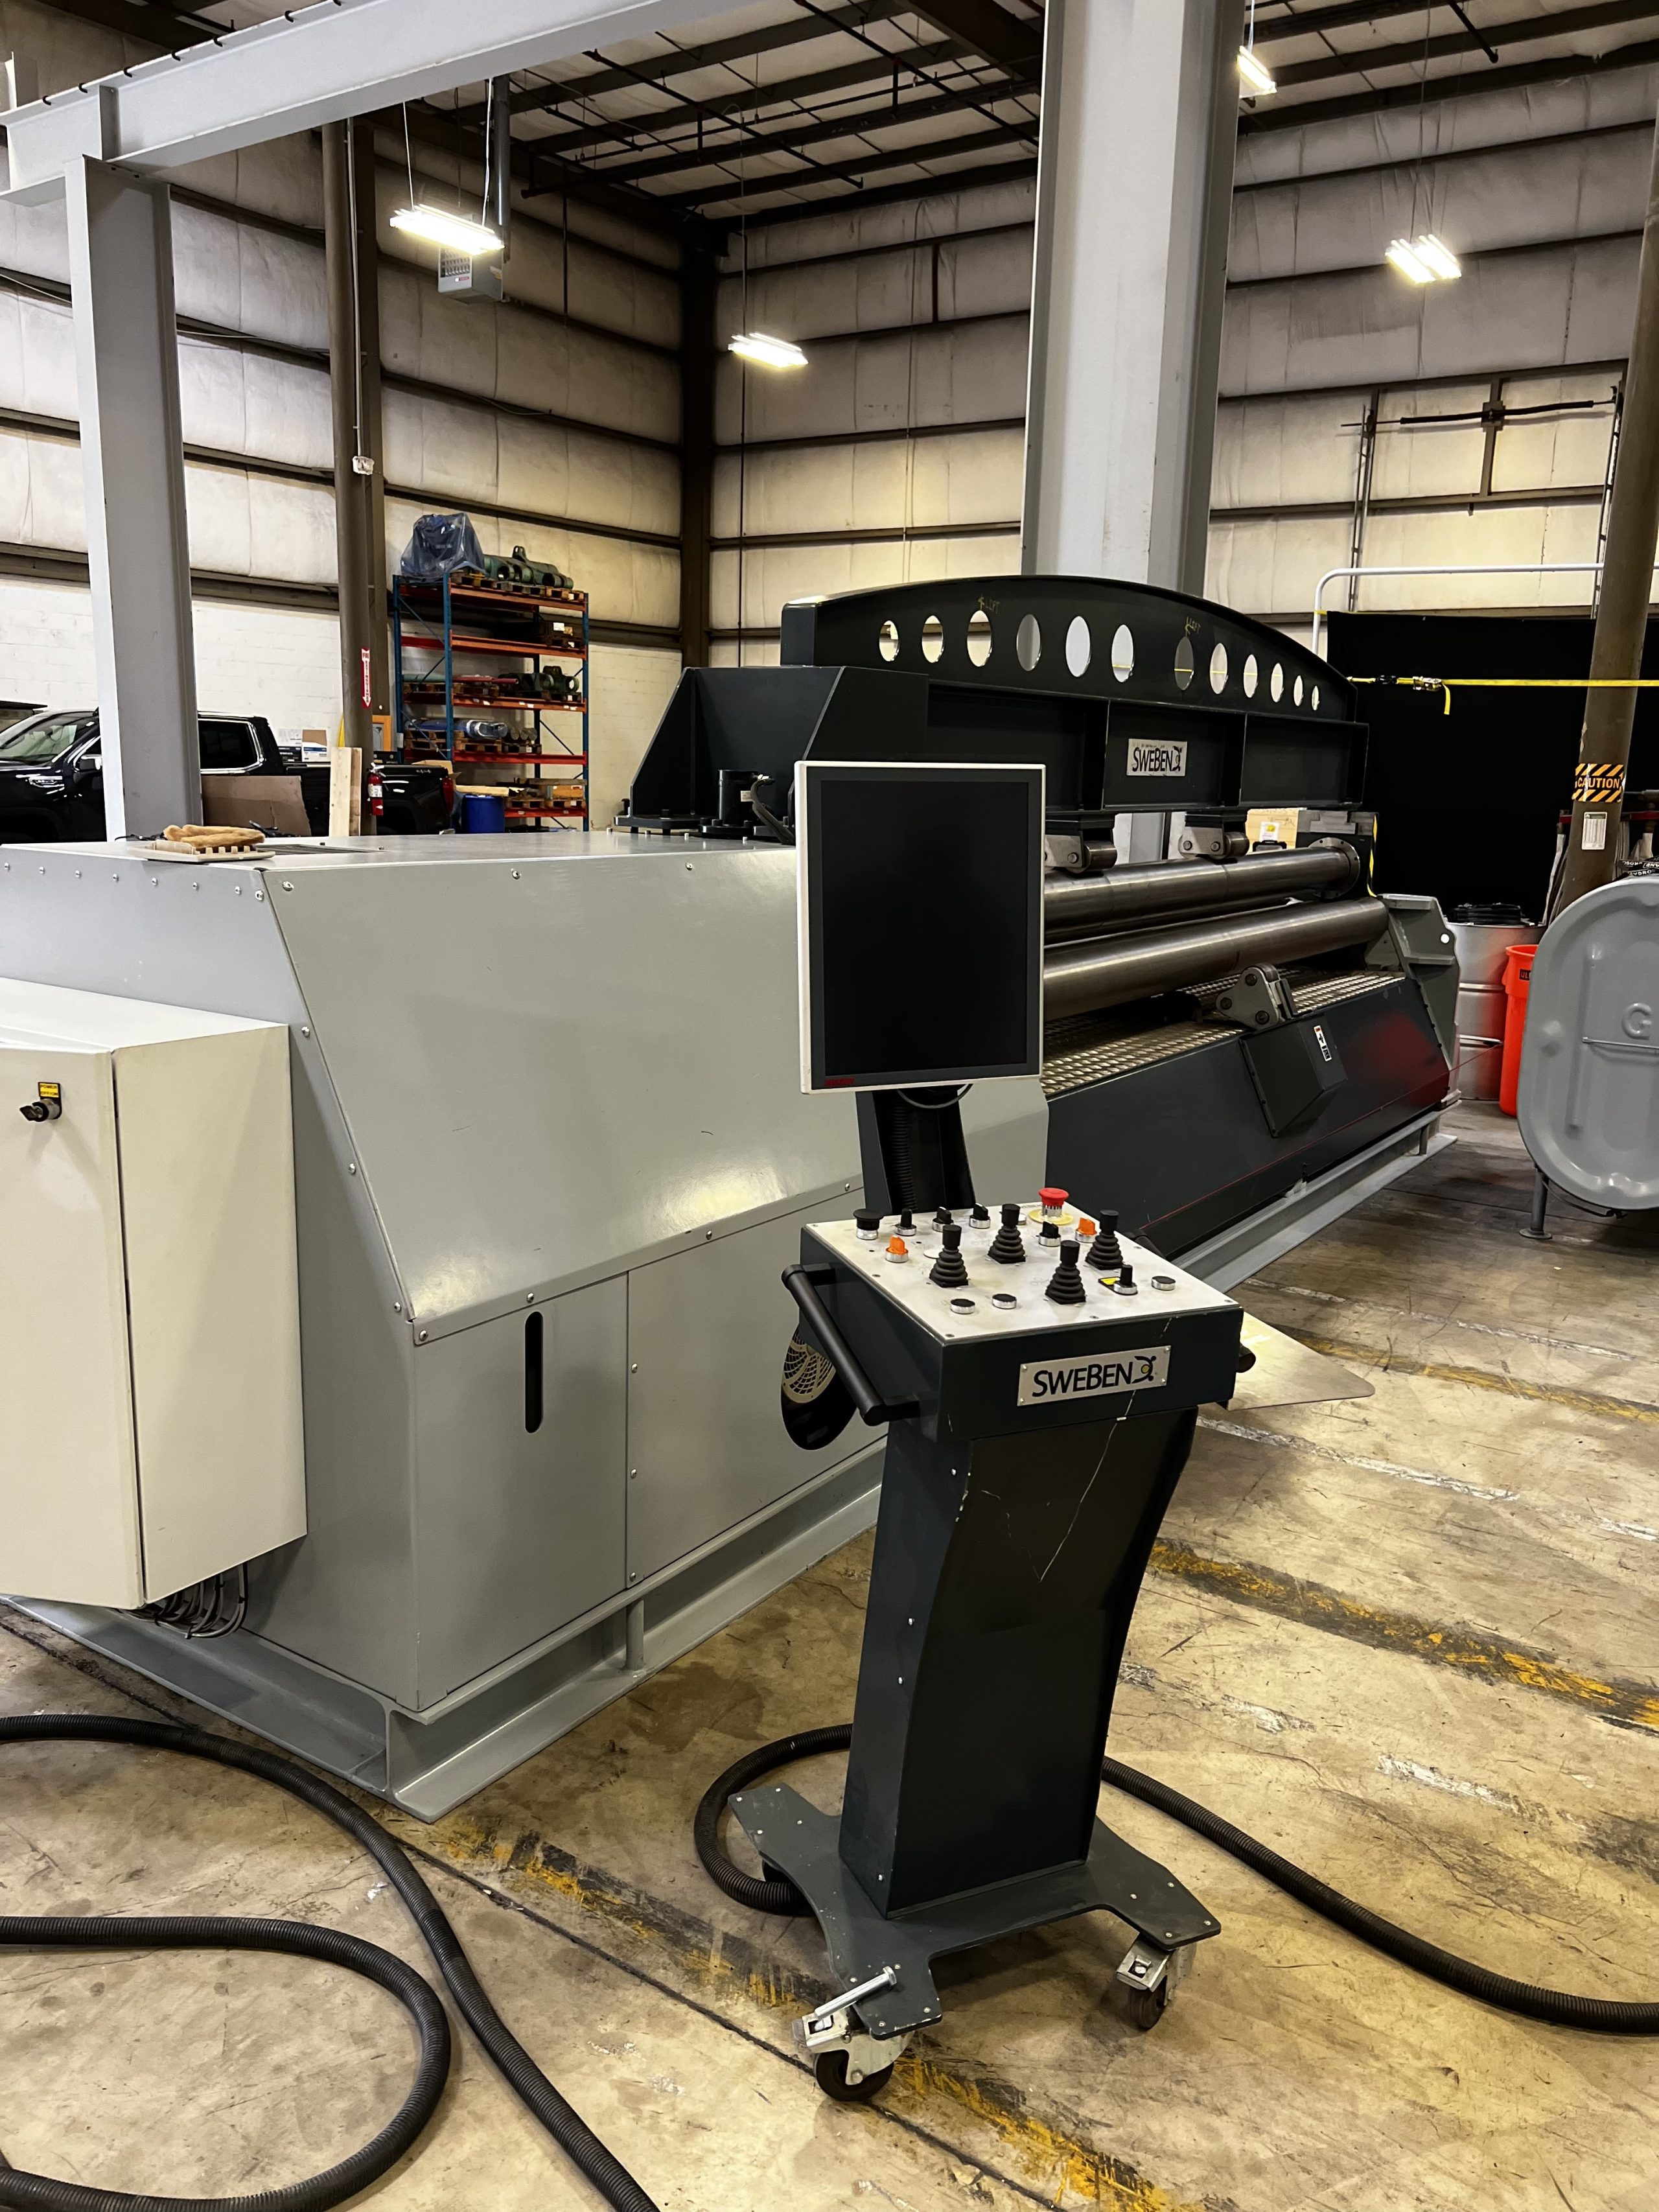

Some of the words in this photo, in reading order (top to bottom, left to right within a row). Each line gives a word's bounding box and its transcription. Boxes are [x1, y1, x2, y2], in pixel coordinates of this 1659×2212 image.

[1132, 747, 1173, 772] SWEBEN
[1577, 778, 1620, 789] CAUTION
[1032, 1362, 1133, 1397] SWEBEN
